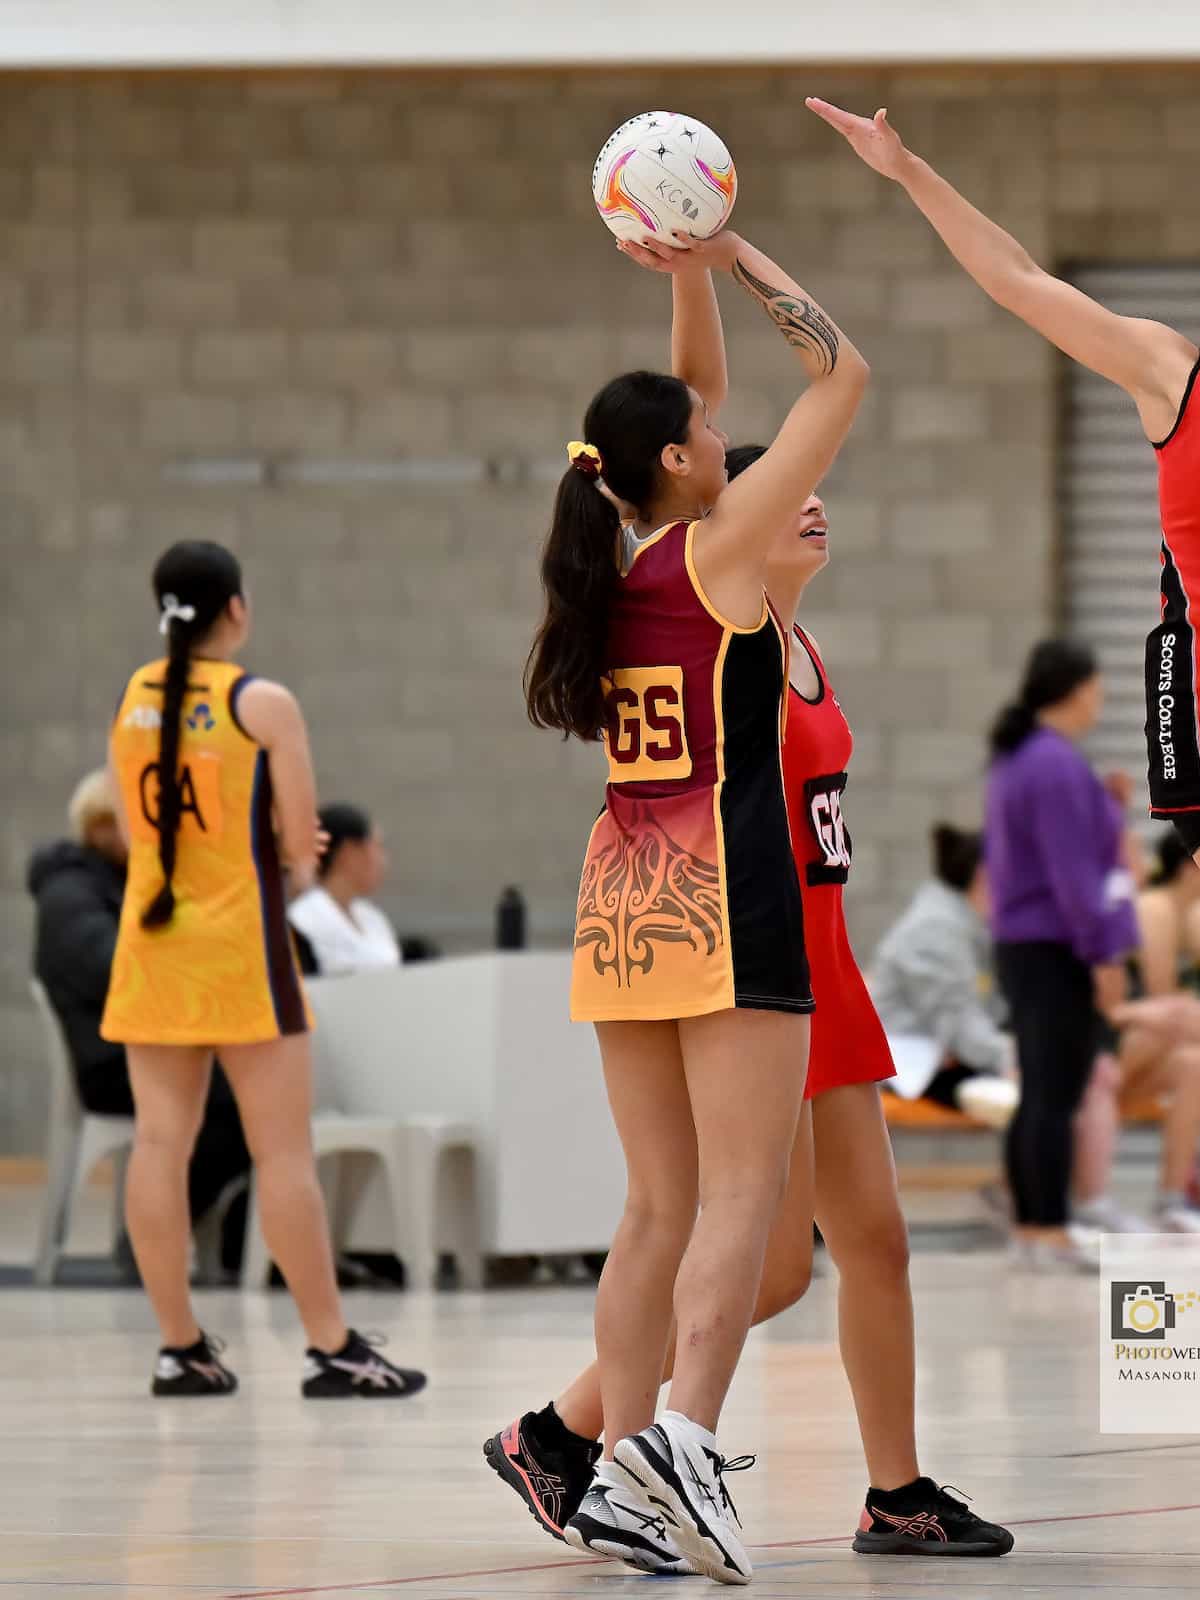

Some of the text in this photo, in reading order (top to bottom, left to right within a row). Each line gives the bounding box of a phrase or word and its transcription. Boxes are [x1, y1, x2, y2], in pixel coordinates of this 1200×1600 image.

[606, 684, 684, 763] GS
[1158, 632, 1177, 780] SCOTS COLLEGE
